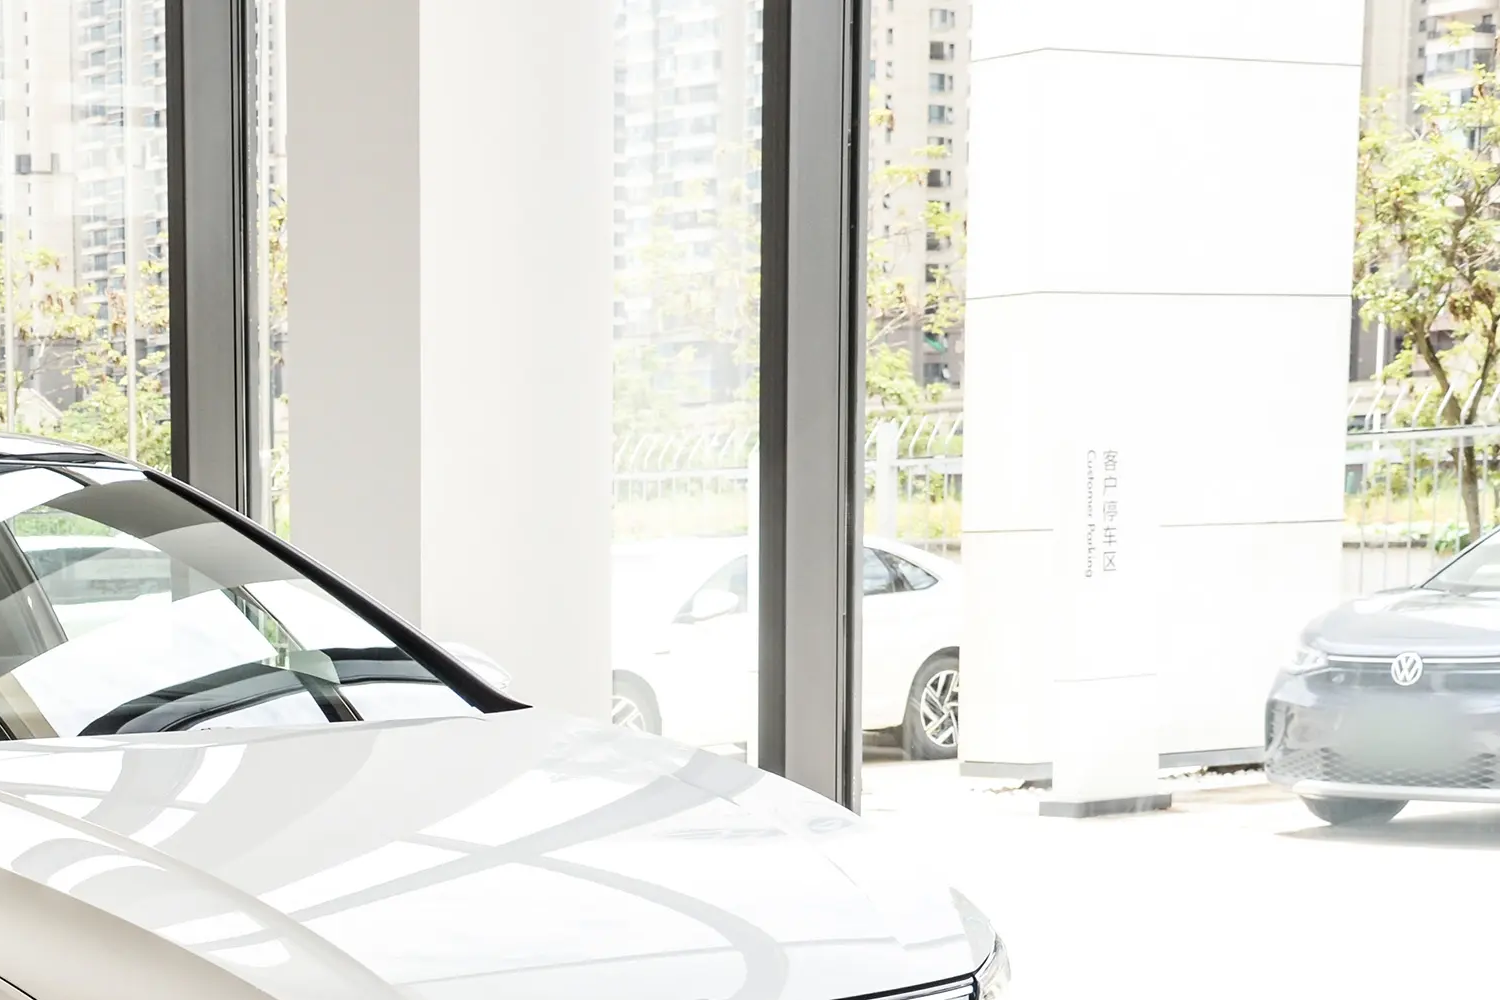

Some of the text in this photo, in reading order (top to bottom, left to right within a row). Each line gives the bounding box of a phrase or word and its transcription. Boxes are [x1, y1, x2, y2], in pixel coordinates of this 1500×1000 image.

[1084, 449, 1097, 578] Customer Parking
[1102, 449, 1119, 572] 客户停车区
